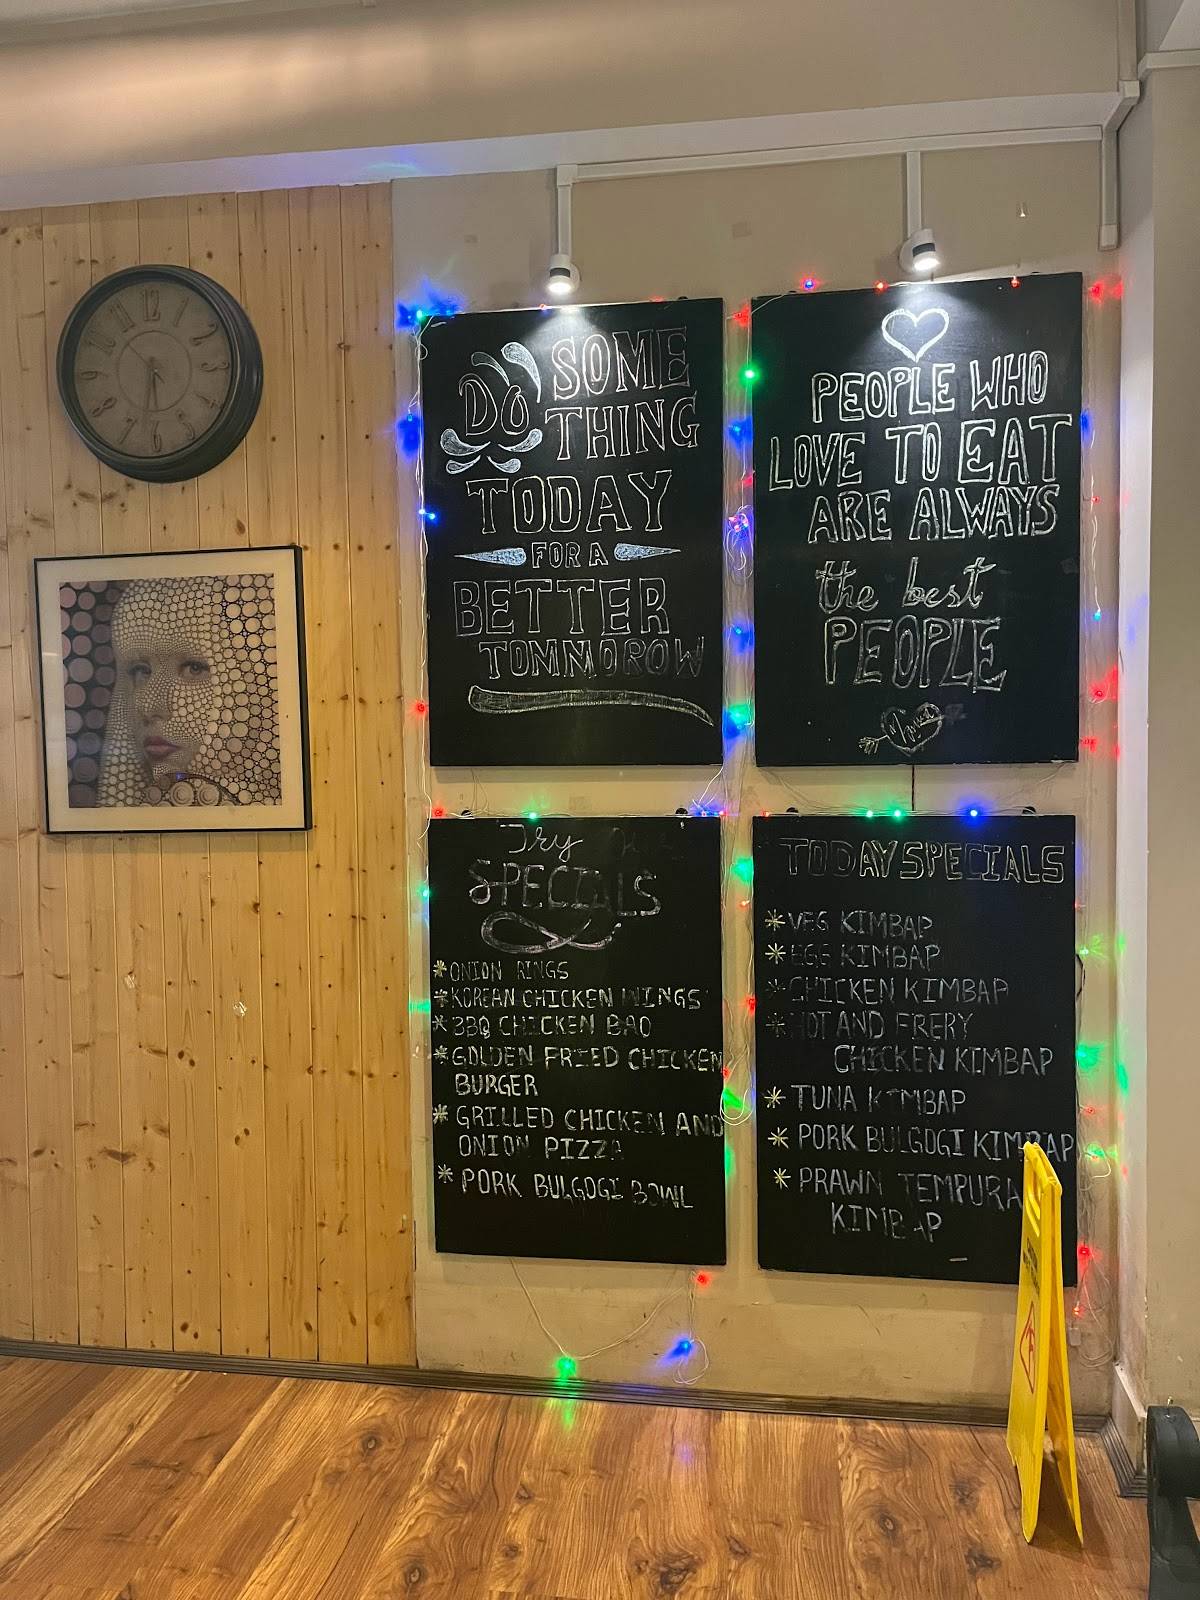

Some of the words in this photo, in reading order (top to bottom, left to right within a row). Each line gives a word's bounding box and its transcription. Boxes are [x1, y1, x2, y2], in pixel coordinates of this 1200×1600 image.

[552, 326, 690, 400] SOME
[811, 362, 955, 424] PEOPLE
[969, 350, 1049, 411] WHO
[459, 373, 530, 437] DO
[545, 390, 700, 461] THING
[769, 432, 866, 492] LOVE
[885, 421, 942, 485] TO
[957, 413, 1073, 485] EAT
[466, 469, 672, 534] TODAY
[807, 489, 892, 544] ARE
[908, 483, 1060, 541] ALWAYS
[531, 541, 581, 568] FOR
[588, 542, 608, 566] A
[815, 560, 879, 614] the
[901, 556, 997, 609] best
[453, 577, 670, 637] BETTER
[824, 614, 1007, 694] PEOPLE
[499, 823, 584, 862] Try
[841, 909, 933, 940] KIMBAP
[450, 960, 502, 982] ONION
[516, 960, 569, 980] RINGS
[840, 943, 941, 972] KIMBAP
[451, 986, 515, 1009] KOREAN
[522, 987, 613, 1009] CHICKEN
[789, 976, 895, 1005] CHICKEN
[904, 977, 1009, 1005] KIMBAP
[606, 1014, 652, 1037] BAO
[836, 1010, 884, 1039] AND
[451, 1044, 533, 1067] GOLDEN
[543, 1046, 619, 1069] FRIED
[627, 1047, 723, 1072] CHICKEN
[834, 1044, 944, 1073] CHICKEN
[955, 1046, 1053, 1077] KIMBAP
[455, 1073, 539, 1097] BURGER
[790, 1084, 858, 1112] TUNA
[456, 1105, 554, 1129] GRILLED
[564, 1109, 666, 1136] CHICKEN
[675, 1112, 724, 1137] AND
[459, 1134, 530, 1157] ONION
[799, 1123, 859, 1151] PORK
[462, 1168, 523, 1198] PORK
[800, 1167, 883, 1195] PRAWN
[897, 1172, 1023, 1211] TEMPURA
